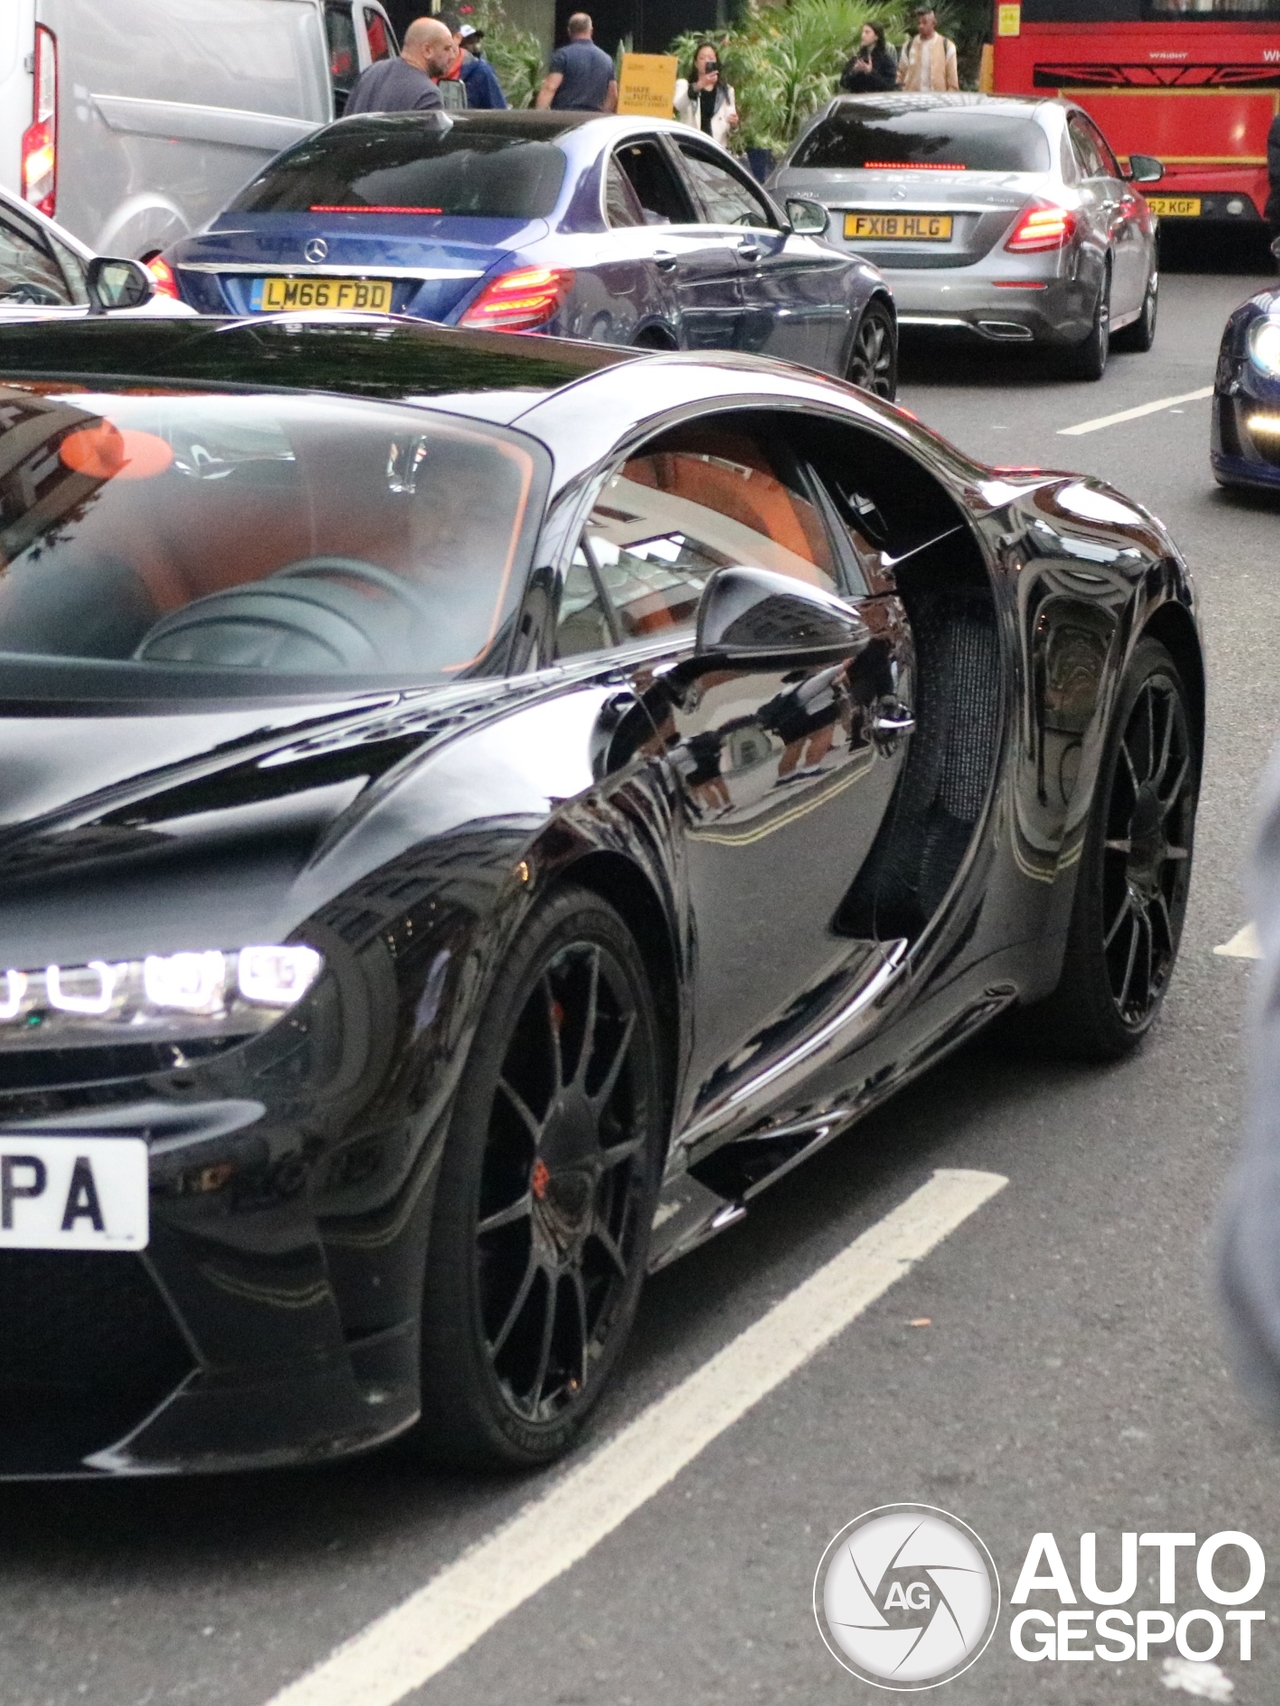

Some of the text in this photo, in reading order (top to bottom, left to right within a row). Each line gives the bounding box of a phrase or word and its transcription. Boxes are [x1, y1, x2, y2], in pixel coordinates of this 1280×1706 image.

[1169, 201, 1195, 213] KGF
[855, 217, 940, 236] FX18 HLG
[267, 282, 385, 308] LM66 FBD
